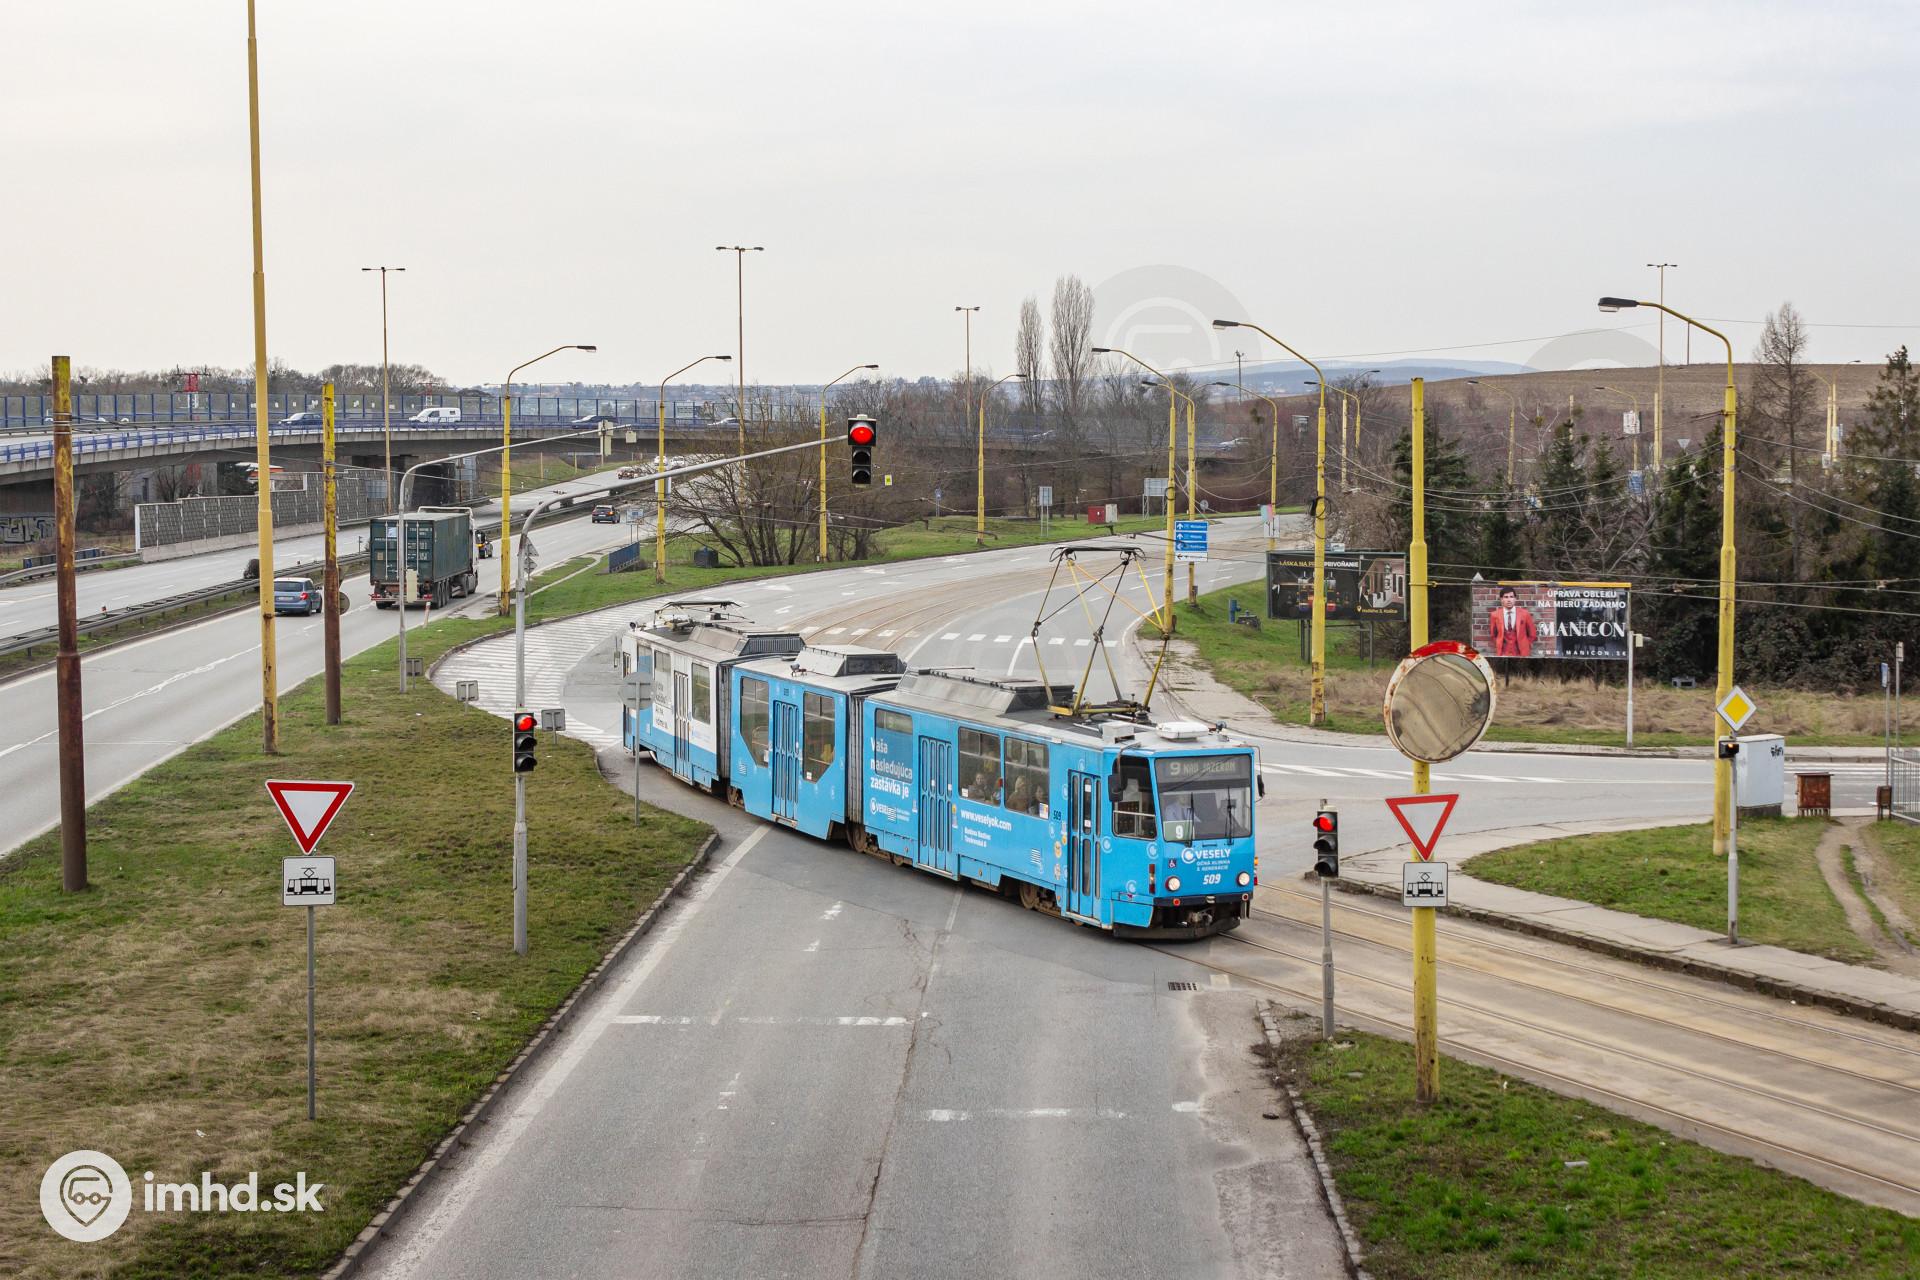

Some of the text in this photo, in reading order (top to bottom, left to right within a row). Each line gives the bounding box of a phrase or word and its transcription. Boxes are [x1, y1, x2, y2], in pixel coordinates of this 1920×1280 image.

[1583, 590, 1617, 598] OBLEKU
[1538, 600, 1551, 608] NA
[1583, 600, 1626, 609] ZADARMO
[1538, 621, 1626, 638] MANICON
[871, 737, 888, 755] Vaša
[870, 757, 913, 780] nasledujúca
[1170, 761, 1181, 775] 9
[870, 776, 909, 799] zastávka je
[960, 809, 1012, 832] www.veselyok.com
[1175, 825, 1184, 839] 9
[1195, 848, 1231, 860] VESELY
[1202, 873, 1221, 885] 509
